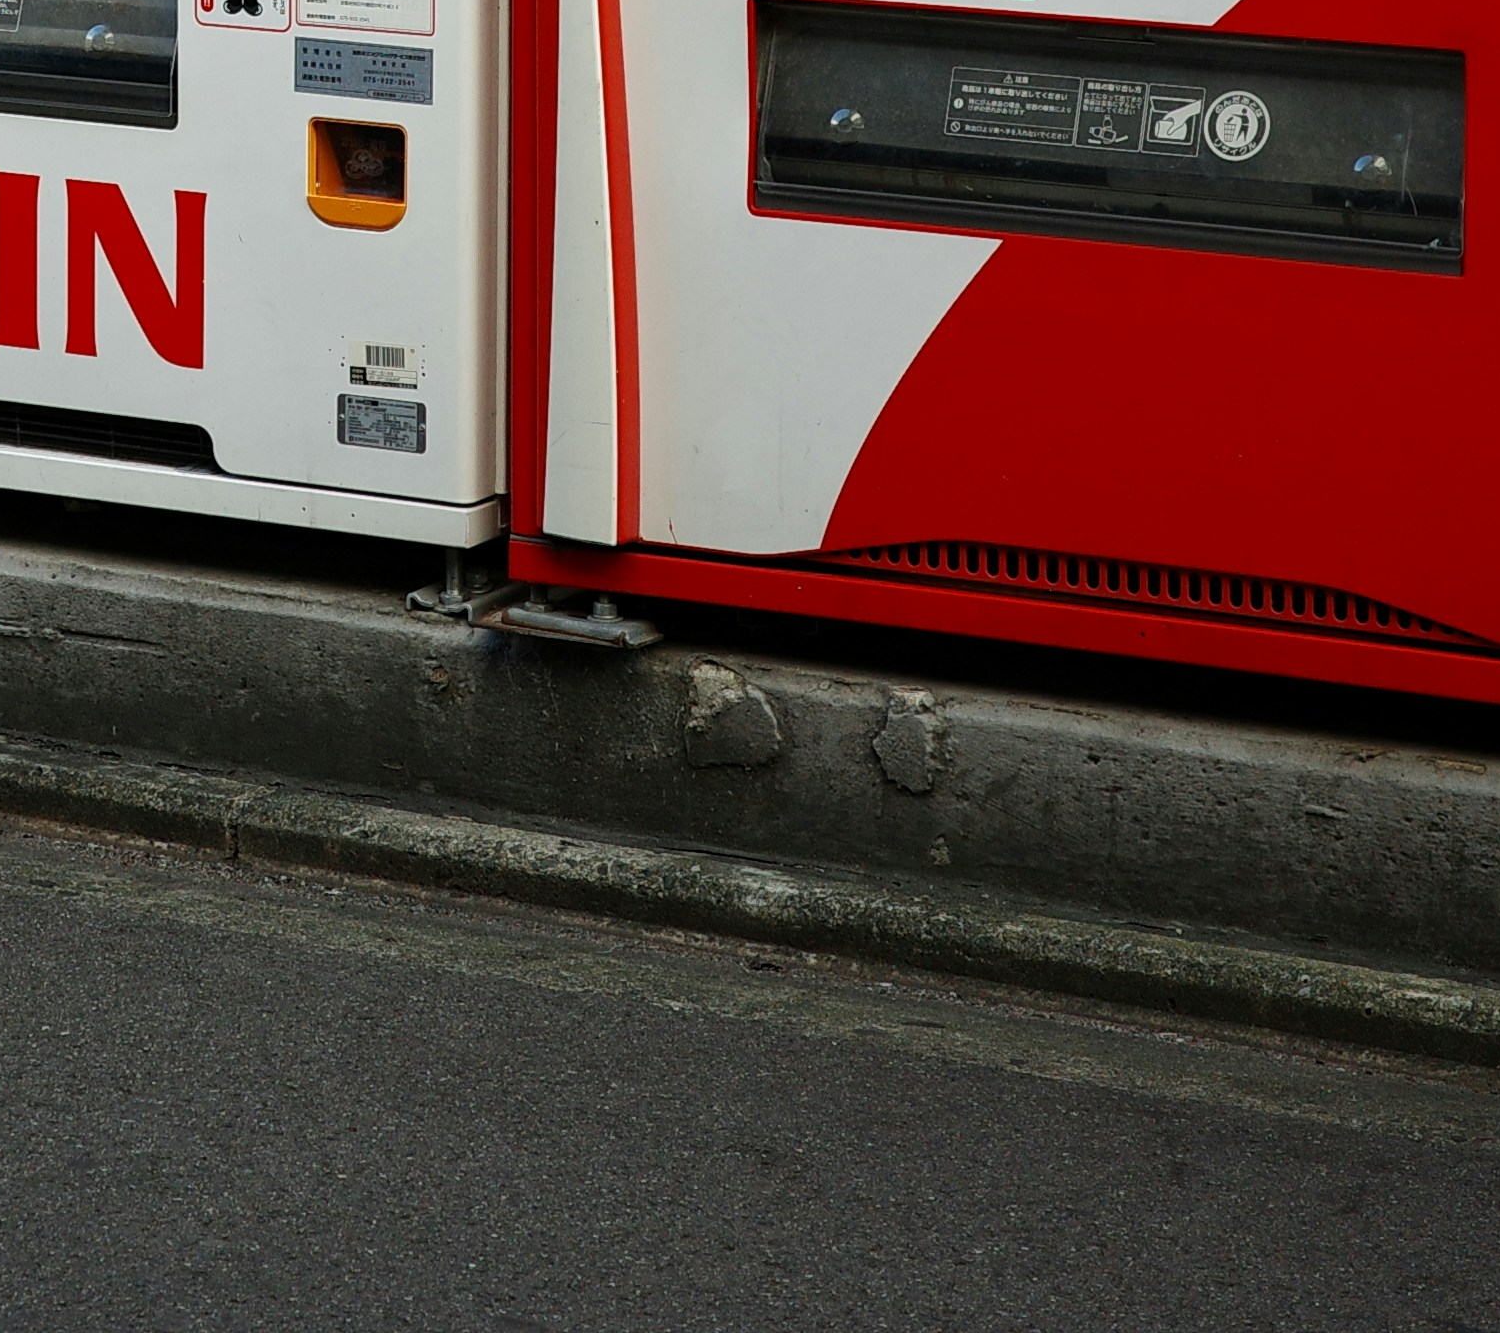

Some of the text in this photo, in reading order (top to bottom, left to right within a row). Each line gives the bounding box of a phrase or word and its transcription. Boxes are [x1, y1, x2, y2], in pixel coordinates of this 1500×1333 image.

[1213, 139, 1257, 155] リサイクル
